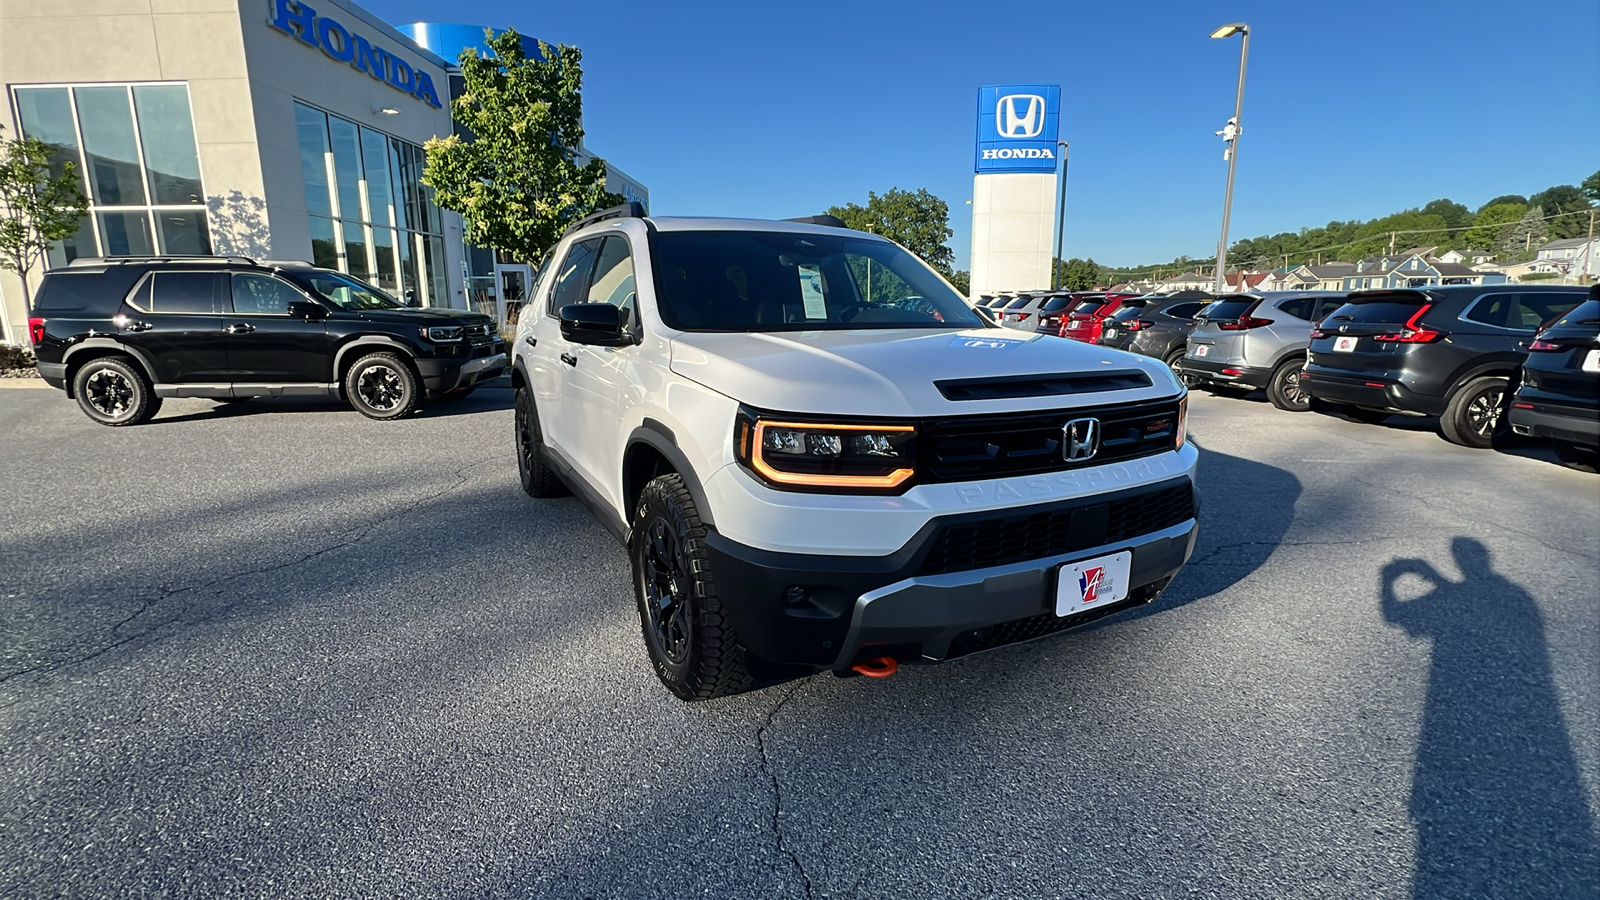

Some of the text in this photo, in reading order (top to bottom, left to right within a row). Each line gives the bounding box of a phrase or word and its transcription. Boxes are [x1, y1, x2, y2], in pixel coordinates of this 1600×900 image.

[267, 0, 443, 109] HONDA
[981, 148, 1055, 160] HONDA
[955, 457, 1172, 505] PASSPORT
